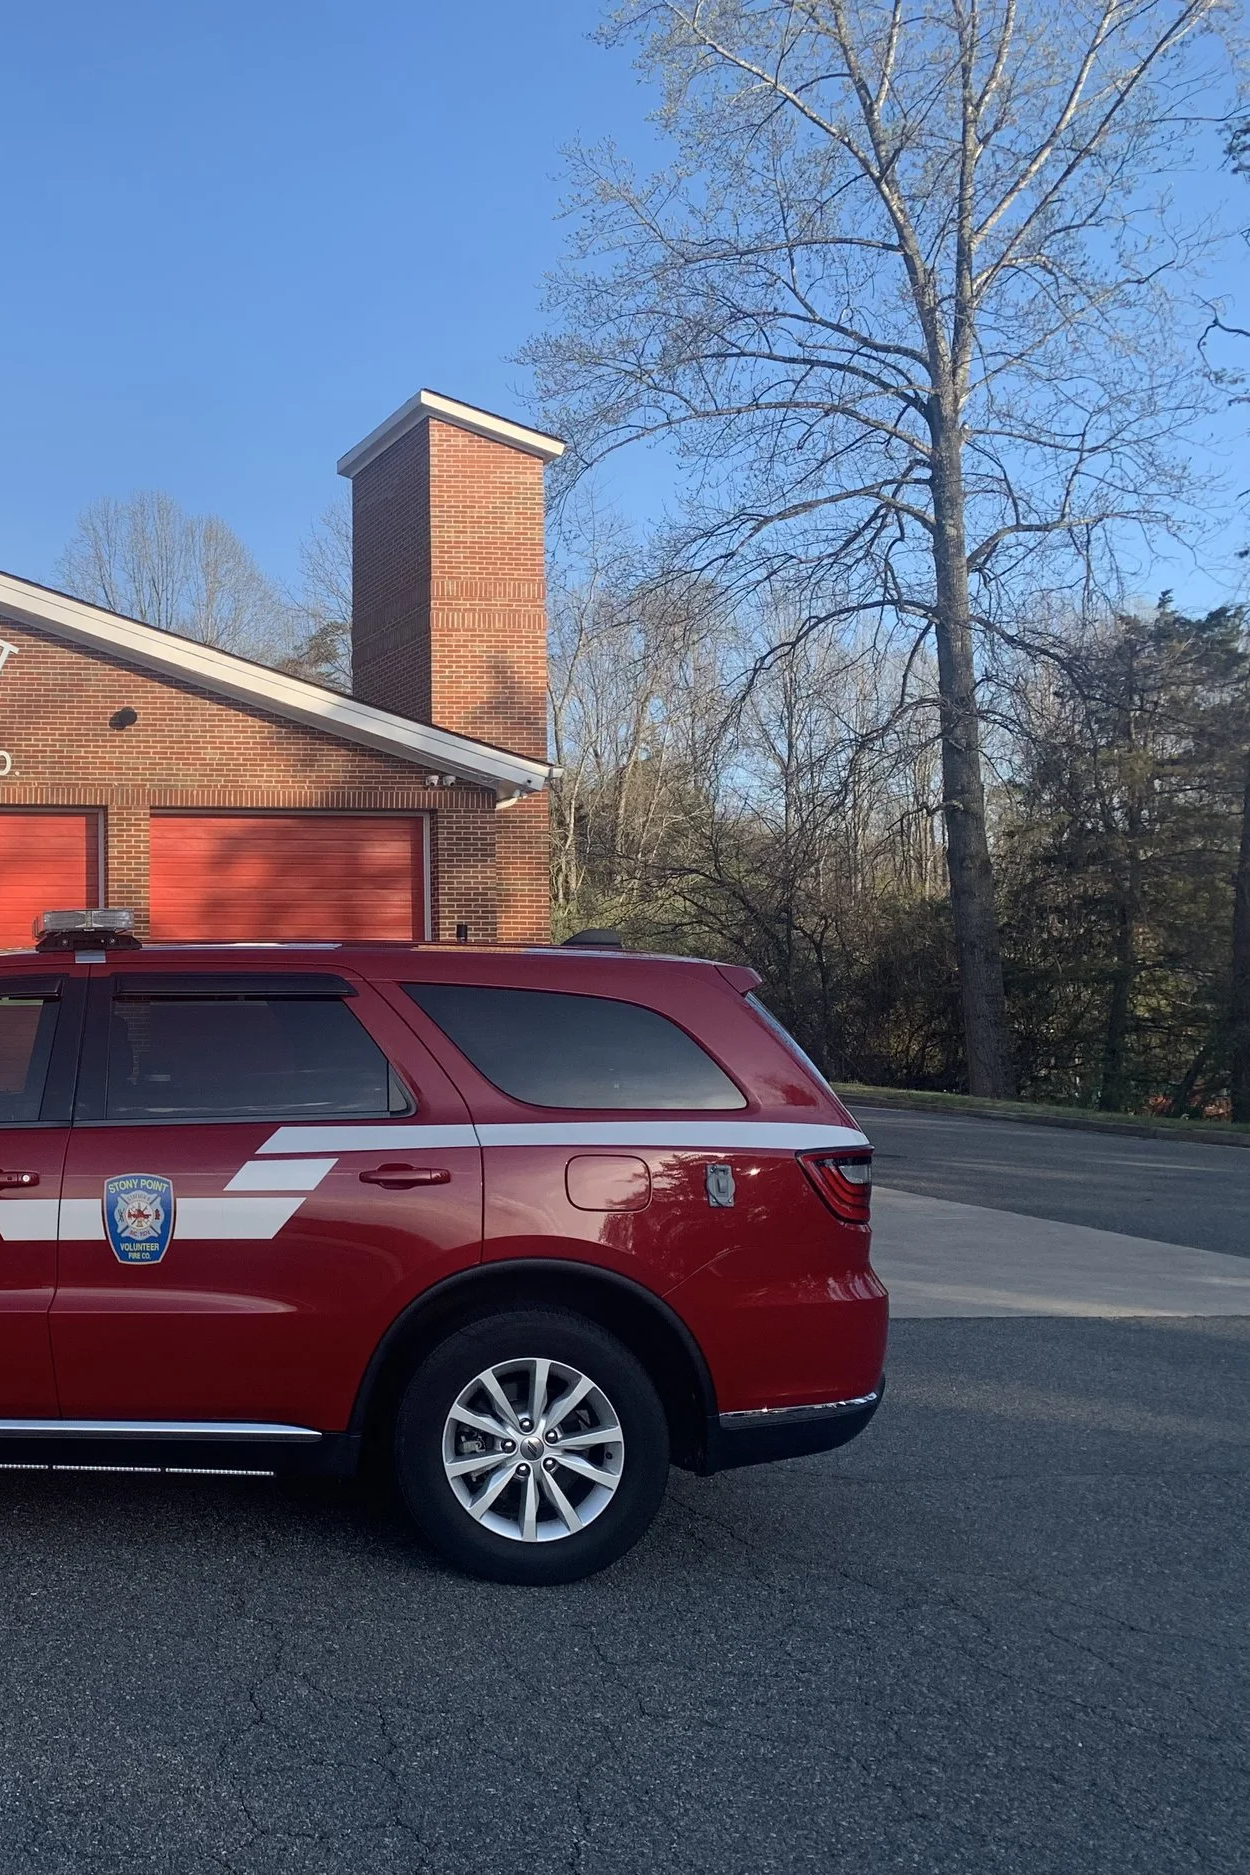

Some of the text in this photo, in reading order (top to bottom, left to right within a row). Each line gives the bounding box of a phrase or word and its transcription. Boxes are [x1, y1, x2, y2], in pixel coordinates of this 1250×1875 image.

[108, 1179, 168, 1193] STONY POINT
[120, 1243, 159, 1251] VOLUNTEER
[128, 1252, 141, 1260] FIRE
